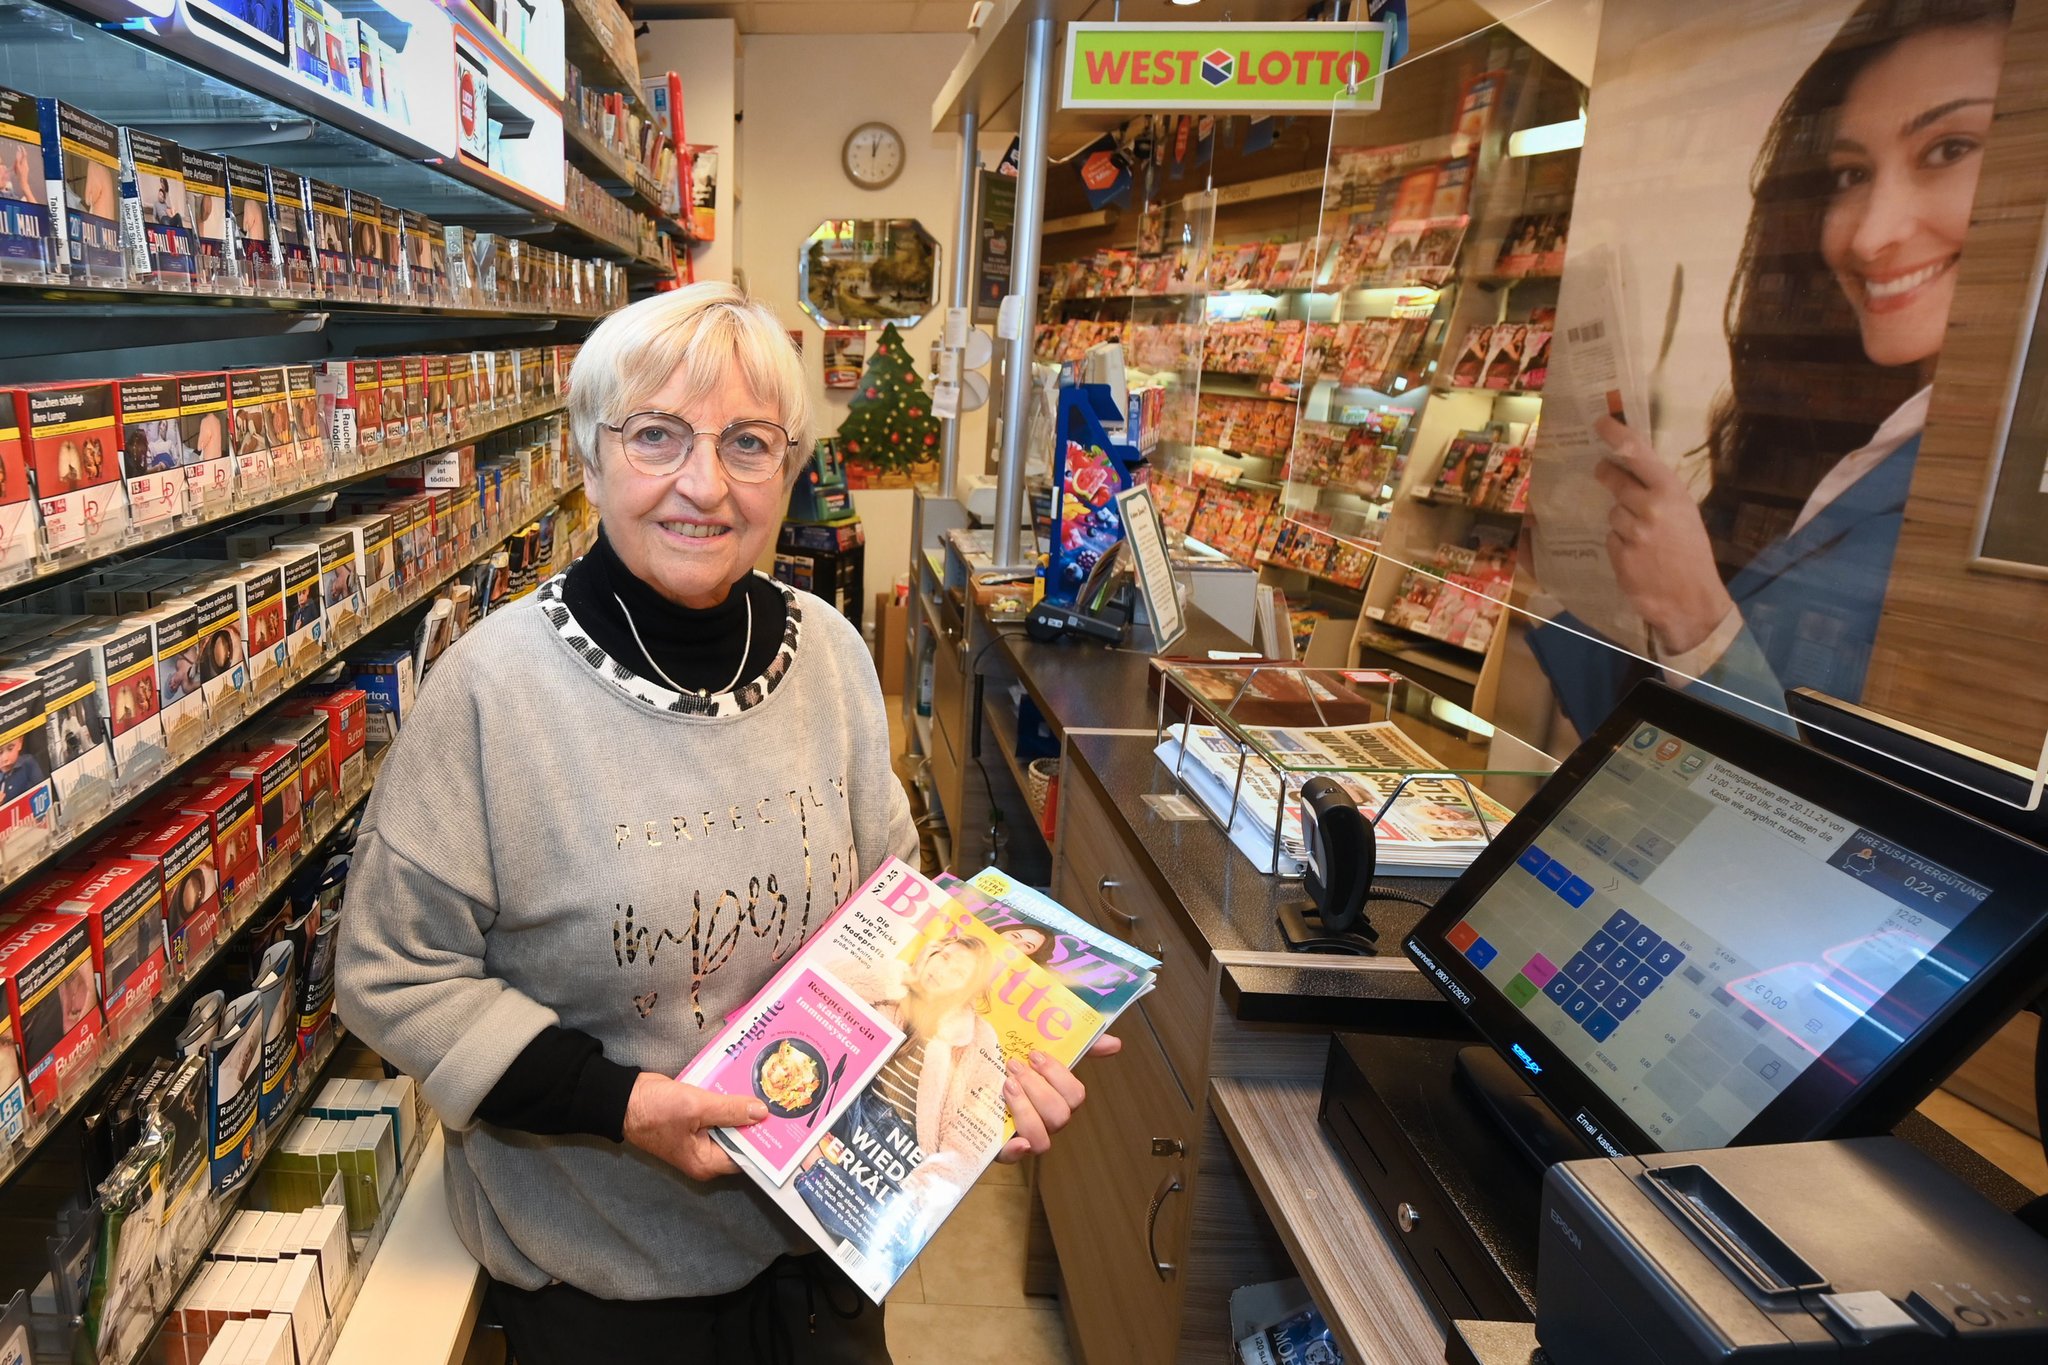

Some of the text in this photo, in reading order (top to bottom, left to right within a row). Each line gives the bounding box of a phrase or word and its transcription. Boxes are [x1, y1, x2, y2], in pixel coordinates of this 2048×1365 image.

[1084, 50, 1371, 86] WEST LOTTO
[31, 397, 60, 410] Rauchen
[32, 411, 67, 424] Ihre Lunge
[426, 458, 457, 466] Rauchen
[430, 475, 454, 484] tödlich
[106, 641, 128, 657] Rauchen
[347, 727, 363, 745] Burton
[1705, 773, 1728, 791] 13:00
[1734, 786, 1758, 803] 14:00
[1757, 798, 1773, 813] Uhr.
[1772, 805, 1788, 820] Sie
[1787, 813, 1819, 836] können
[1818, 828, 1834, 843] die
[1713, 762, 1776, 800] Wartungsarbeiten
[1775, 791, 1790, 805] am
[1789, 800, 1829, 825] 20.11.24
[1828, 820, 1846, 834] von
[615, 776, 844, 850] PERFECTLY
[1708, 787, 1808, 846] Kasse wie gewohnt nutzen.
[163, 824, 210, 867] Rauchen erhöht das
[164, 837, 210, 880] Risiko zu erblinden
[1855, 831, 1989, 903] IHRE ZUSATZVERGÜTUNG
[77, 866, 133, 900] Burton
[886, 869, 899, 882] 25
[1904, 875, 1948, 904] 0,22 €
[854, 911, 897, 946] Style-Tricks
[876, 916, 890, 928] Die
[1615, 919, 1627, 930] 7
[1894, 907, 1923, 928] 12:02
[832, 938, 849, 951] große
[839, 934, 856, 948] Kleine
[842, 923, 885, 959] Modeprofis
[862, 927, 877, 940] der
[1636, 936, 1648, 947] 8
[1595, 942, 1606, 952] 4
[1659, 953, 1671, 964] 9
[18, 963, 45, 988] Rauchen
[1407, 939, 1437, 972] Kassenhotline
[1448, 980, 1470, 1006] 2129210
[1575, 963, 1585, 973] 1
[1615, 958, 1627, 969] 5
[125, 967, 158, 1005] Burton
[1554, 983, 1565, 994] C
[1594, 979, 1606, 991] 2
[1637, 975, 1649, 986] 6
[20, 987, 33, 1000] und
[1574, 1001, 1585, 1011] 0
[1616, 997, 1627, 1008] 3
[1763, 988, 1789, 1012] 0,00
[808, 981, 875, 1041] Rezepte für ein
[816, 1001, 853, 1034] starkes
[724, 1000, 785, 1060] Brigitte
[795, 996, 861, 1056] Immunsystem
[55, 1032, 95, 1078] Burton
[995, 1043, 1008, 1056] Von
[956, 1108, 993, 1143] Verliebtsein
[1576, 1112, 1598, 1136] Email
[886, 1127, 923, 1168] NIE
[221, 1152, 255, 1189] SAMS
[817, 1158, 826, 1168] So
[824, 1164, 847, 1189] machen
[845, 1185, 856, 1197] wir
[854, 1193, 866, 1206] uns
[804, 1179, 815, 1192] Was
[824, 1199, 838, 1213] wenn
[837, 1212, 845, 1222] es
[843, 1218, 857, 1233] dann
[814, 1179, 863, 1229] Wie auch die Psyche
[823, 1176, 860, 1215] Tipps für starke
[1550, 1207, 1582, 1251] EPSON
